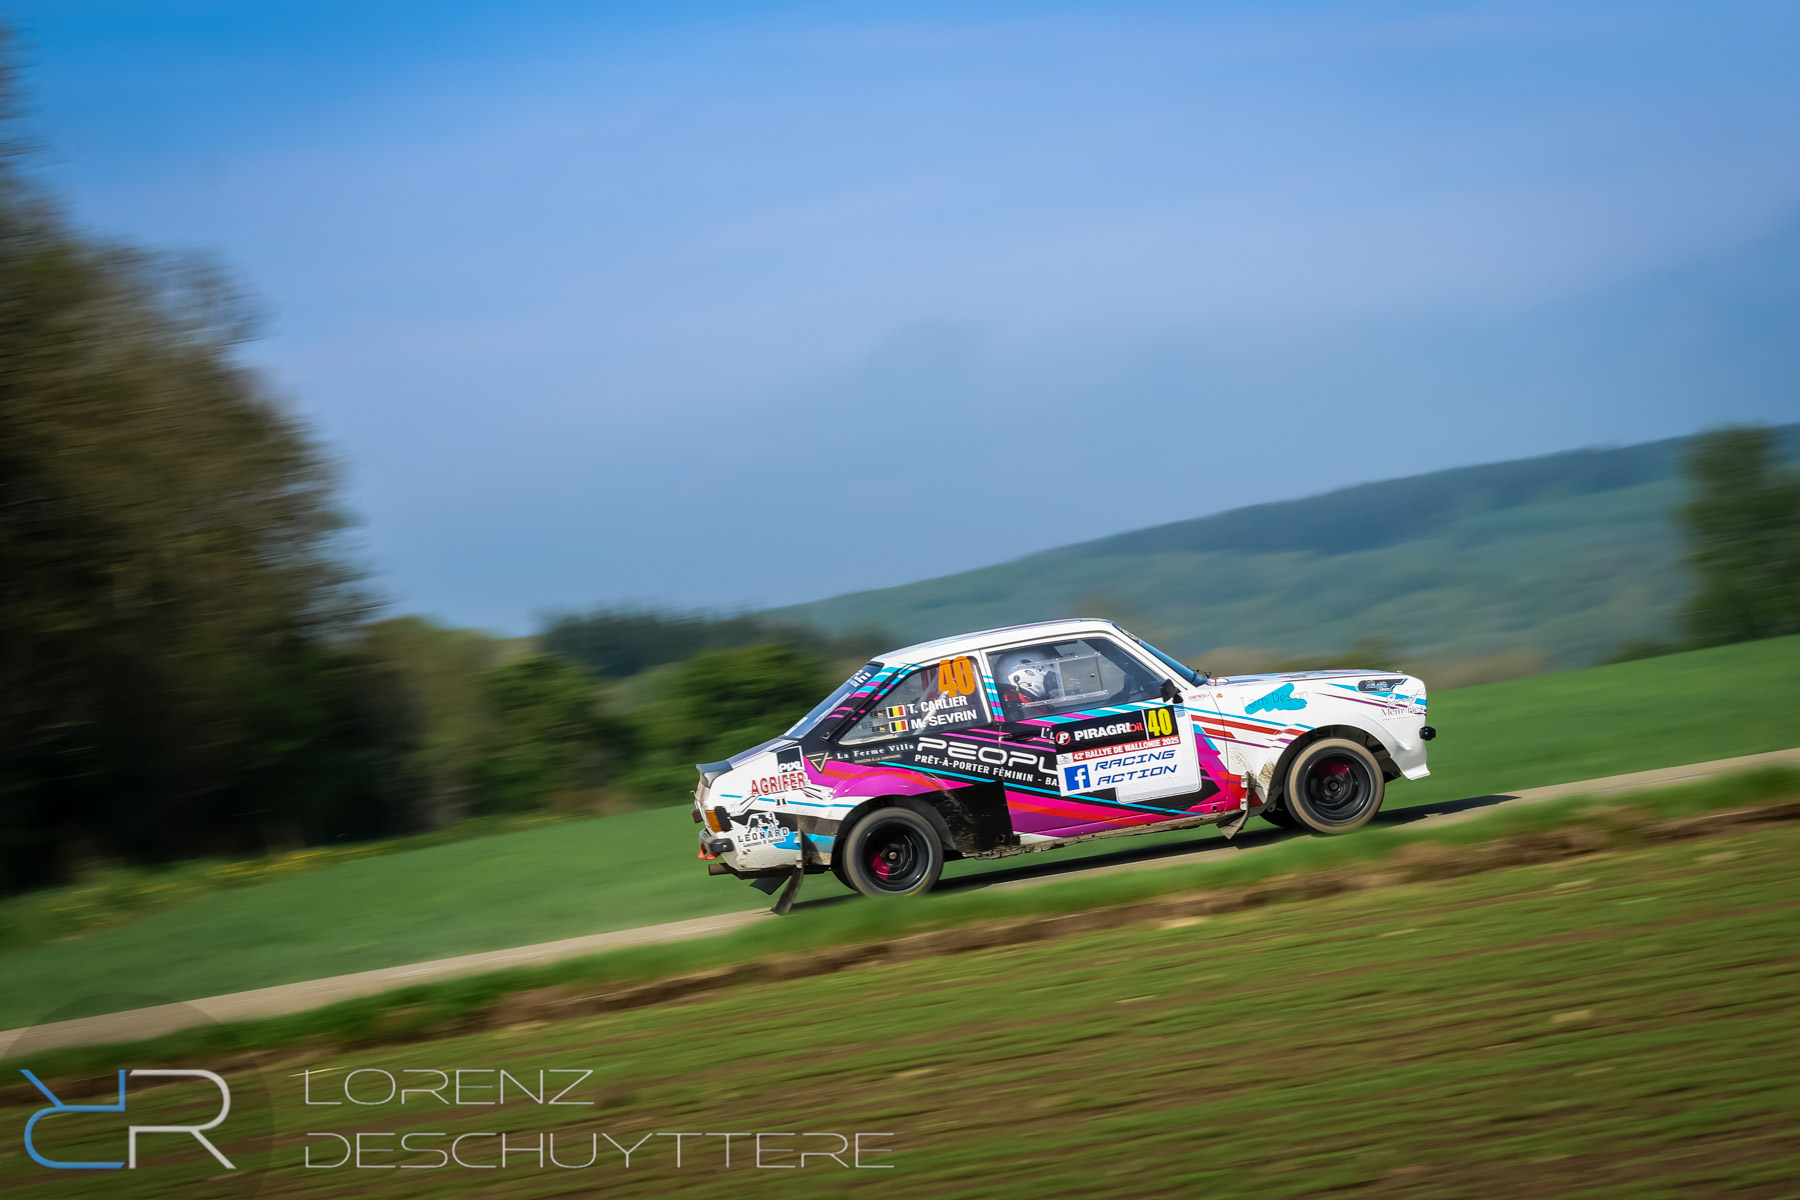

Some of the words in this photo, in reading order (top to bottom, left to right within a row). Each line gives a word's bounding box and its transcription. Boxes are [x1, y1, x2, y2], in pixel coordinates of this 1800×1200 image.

[938, 656, 976, 697] 40
[907, 703, 918, 714] T.
[920, 695, 968, 713] CARLIER
[910, 718, 927, 730] M.
[928, 709, 978, 727] SEVRIN
[1147, 708, 1173, 737] 40
[853, 748, 885, 757] Ferme
[888, 743, 914, 752] Villa
[1085, 746, 1112, 759] RALLYE
[1113, 745, 1124, 754] DE
[1124, 740, 1161, 753] WALLONIE
[1162, 736, 1180, 746] 2025
[915, 754, 989, 775] PRÊT-À-PORTER
[993, 766, 1034, 783] FÉMININ
[1045, 777, 1061, 787] BA
[1094, 750, 1176, 771] RACING
[751, 772, 806, 795] AGRIFER
[1097, 764, 1177, 786] ACTION
[737, 827, 789, 843] LEONARD
